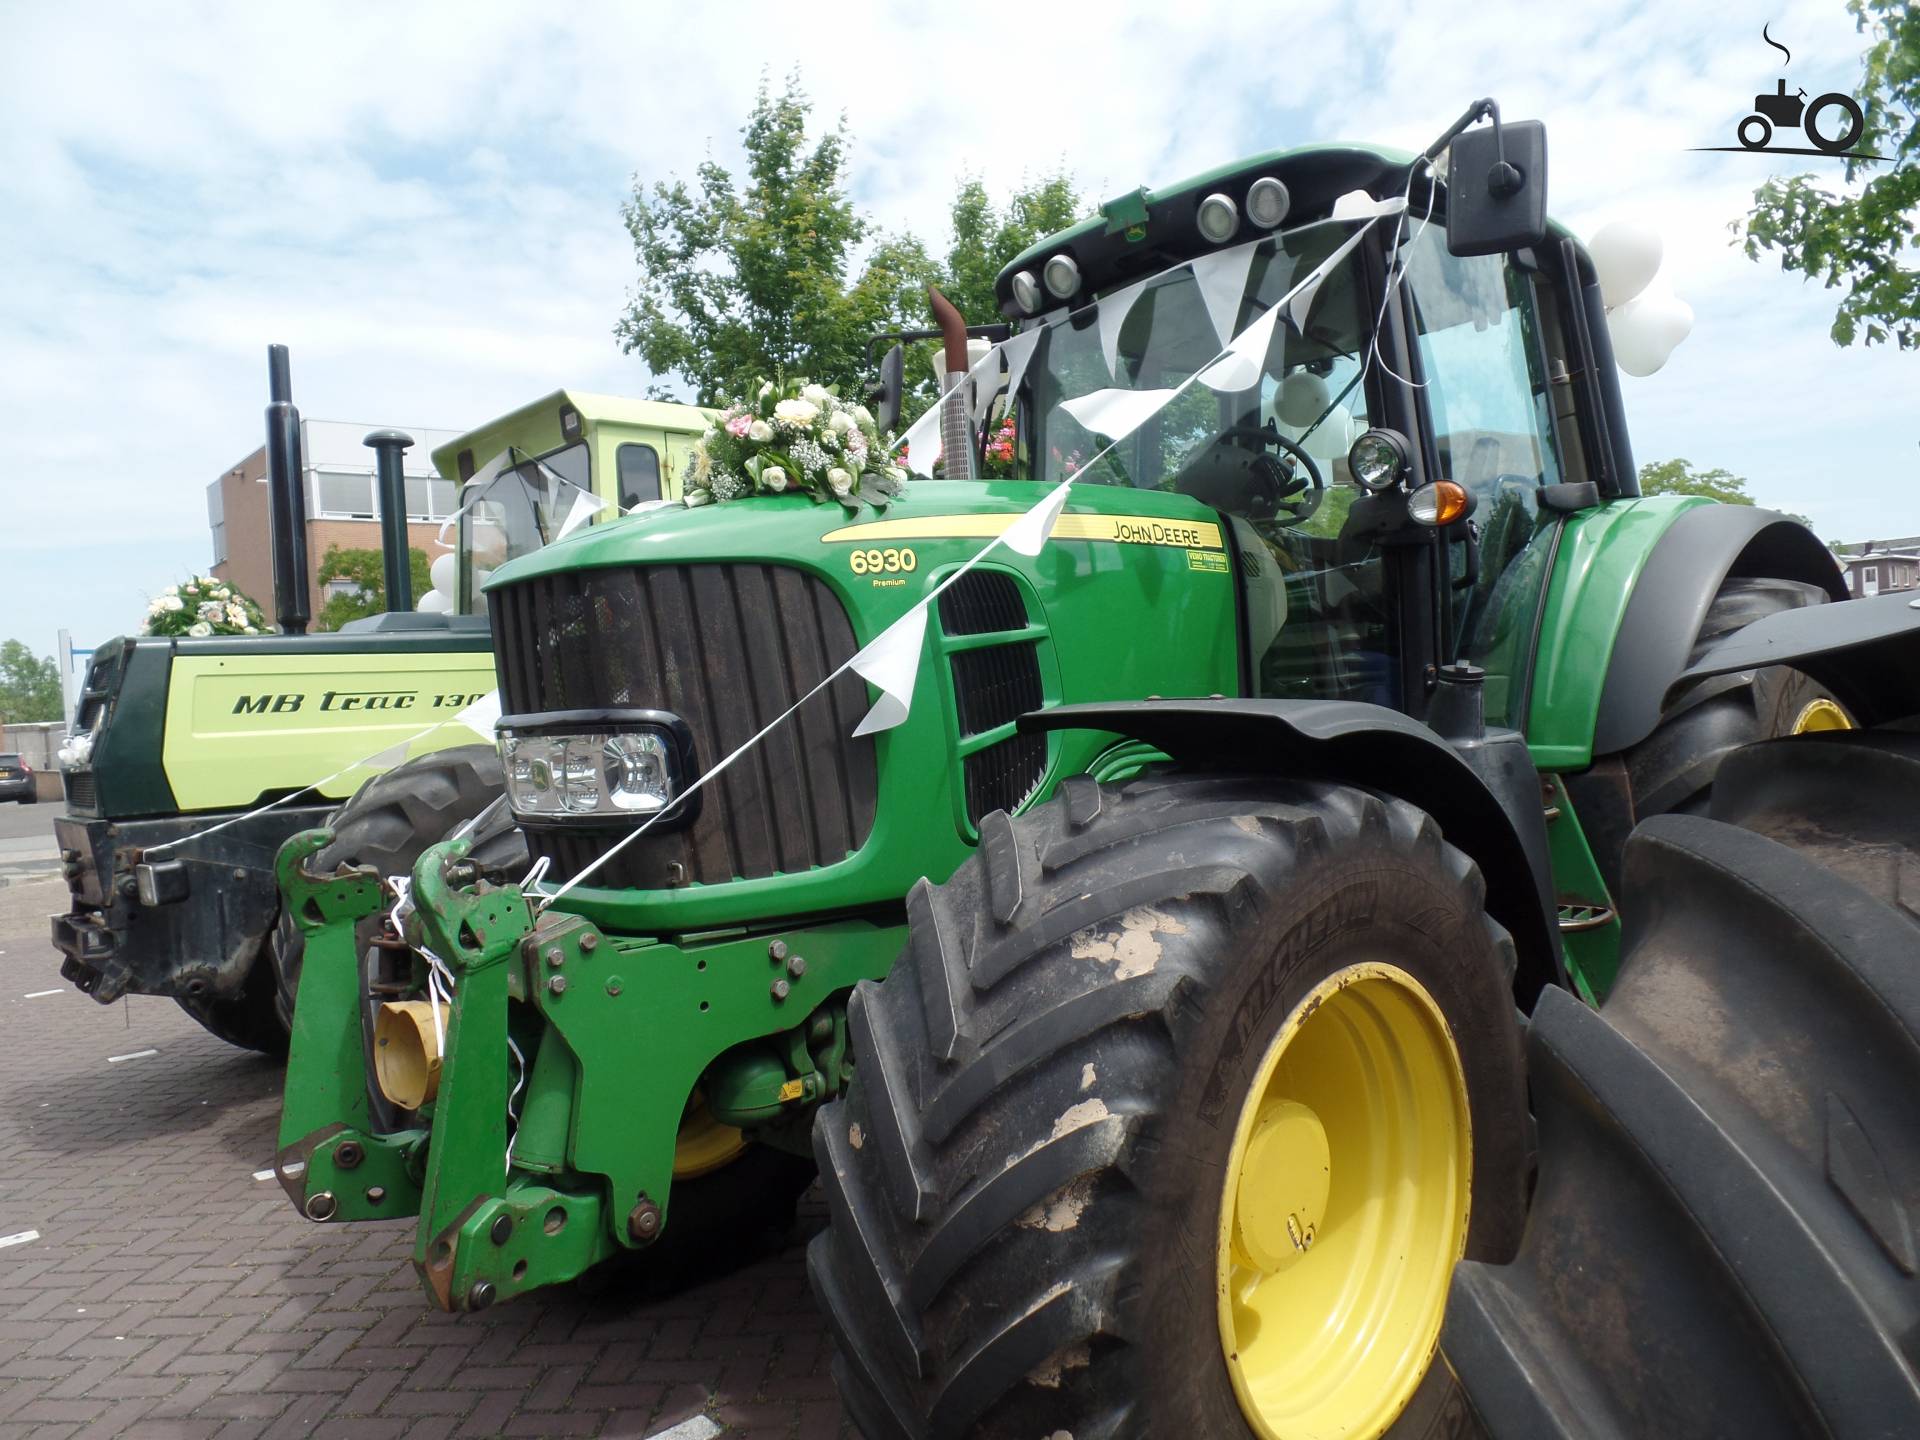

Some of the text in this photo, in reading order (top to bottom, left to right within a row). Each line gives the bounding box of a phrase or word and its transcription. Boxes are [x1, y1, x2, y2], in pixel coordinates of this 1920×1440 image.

[1113, 521, 1201, 545] JOHN DEERE
[850, 548, 917, 575] 6930
[872, 579, 906, 588] Premium
[231, 694, 305, 714] MB
[319, 691, 419, 711] trac
